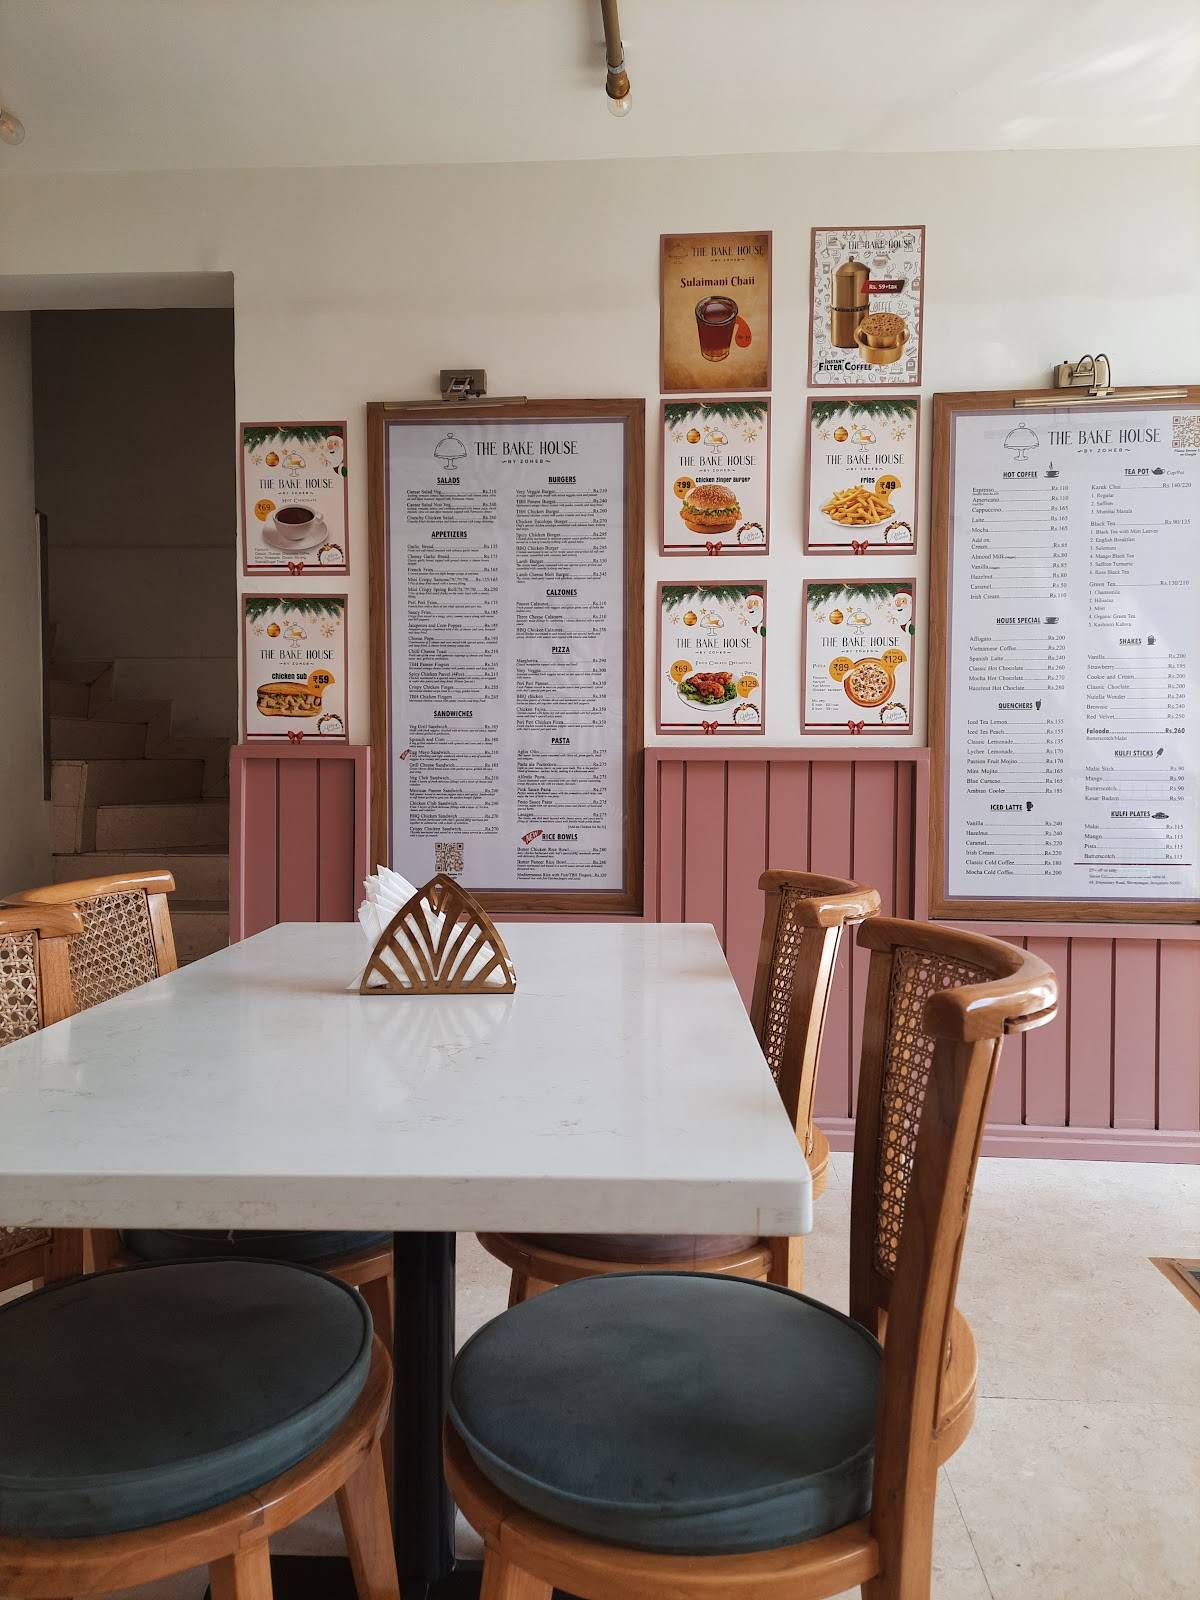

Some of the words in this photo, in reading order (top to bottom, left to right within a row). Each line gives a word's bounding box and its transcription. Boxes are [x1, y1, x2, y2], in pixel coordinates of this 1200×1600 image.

[692, 247, 707, 257] THE
[711, 246, 733, 256] BAKE
[737, 245, 764, 256] HOUSE
[680, 277, 728, 289] Sulaimani
[731, 276, 755, 287] Chaii
[1048, 431, 1072, 446] THE
[1078, 429, 1113, 445] BAKE
[1119, 428, 1162, 444] HOUSE
[474, 440, 498, 456] THE
[502, 440, 534, 456] BAKE
[539, 440, 579, 455] HOUSE
[680, 456, 695, 467] THE
[700, 456, 723, 466] BAKE
[728, 455, 756, 466] HOUSE
[826, 455, 842, 465] THE
[846, 454, 870, 465] BAKE
[876, 454, 904, 464] HOUSE
[259, 480, 275, 490] THE
[279, 479, 302, 489] BAKE
[306, 478, 334, 488] HOUSE
[880, 482, 896, 490] ₹49
[676, 638, 692, 648] THE
[696, 638, 718, 648] BAKE
[724, 638, 752, 648] HOUSE
[822, 637, 840, 648] THE
[842, 636, 866, 647] BAKE
[870, 636, 900, 646] HOUSE
[260, 650, 276, 660] THE
[280, 650, 302, 660] BAKE
[306, 649, 335, 660] HOUSE
[833, 664, 849, 672] ₹89
[272, 672, 295, 680] chicken
[312, 675, 329, 684] ₹59
